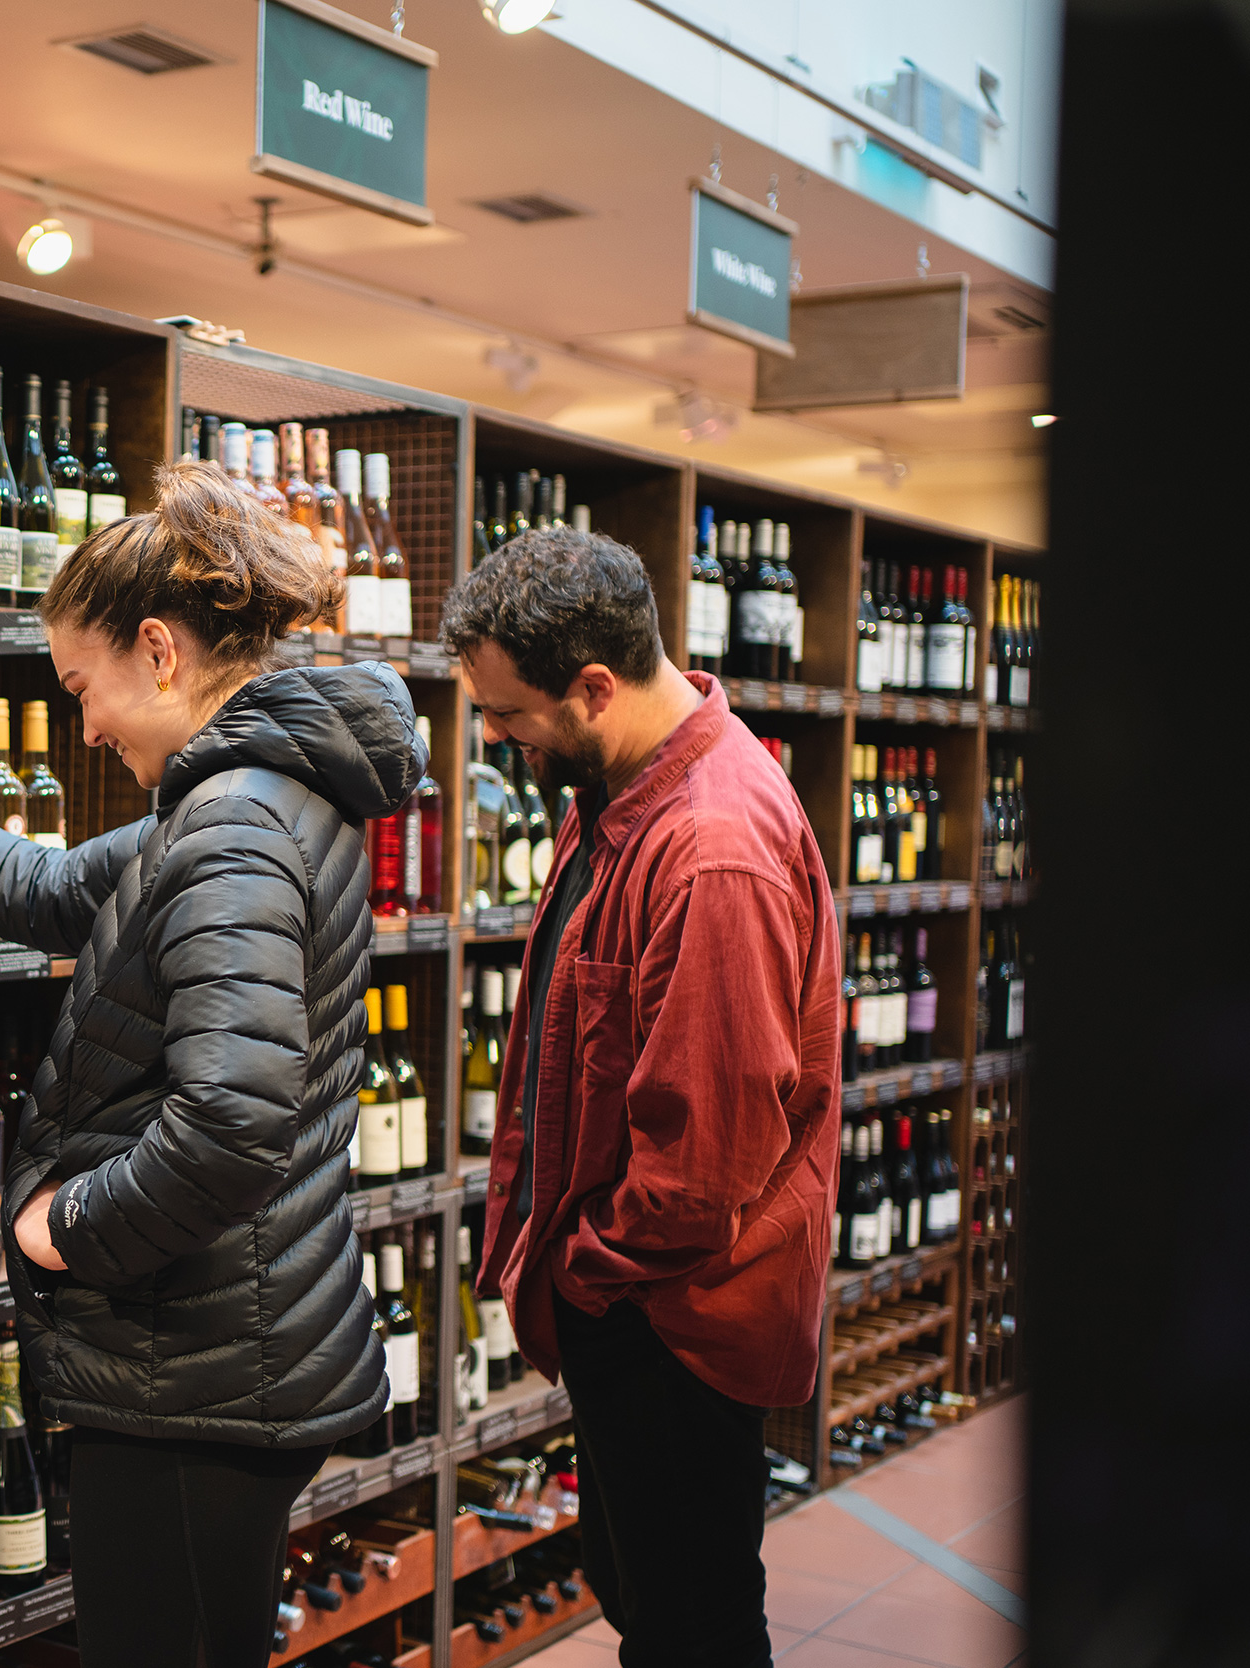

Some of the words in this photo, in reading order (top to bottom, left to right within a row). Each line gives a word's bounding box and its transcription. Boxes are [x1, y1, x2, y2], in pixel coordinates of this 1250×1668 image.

[302, 78, 344, 123] Red
[344, 95, 394, 142] Wine
[711, 246, 748, 287] White
[747, 262, 778, 299] Wine
[64, 1200, 74, 1228] Storm
